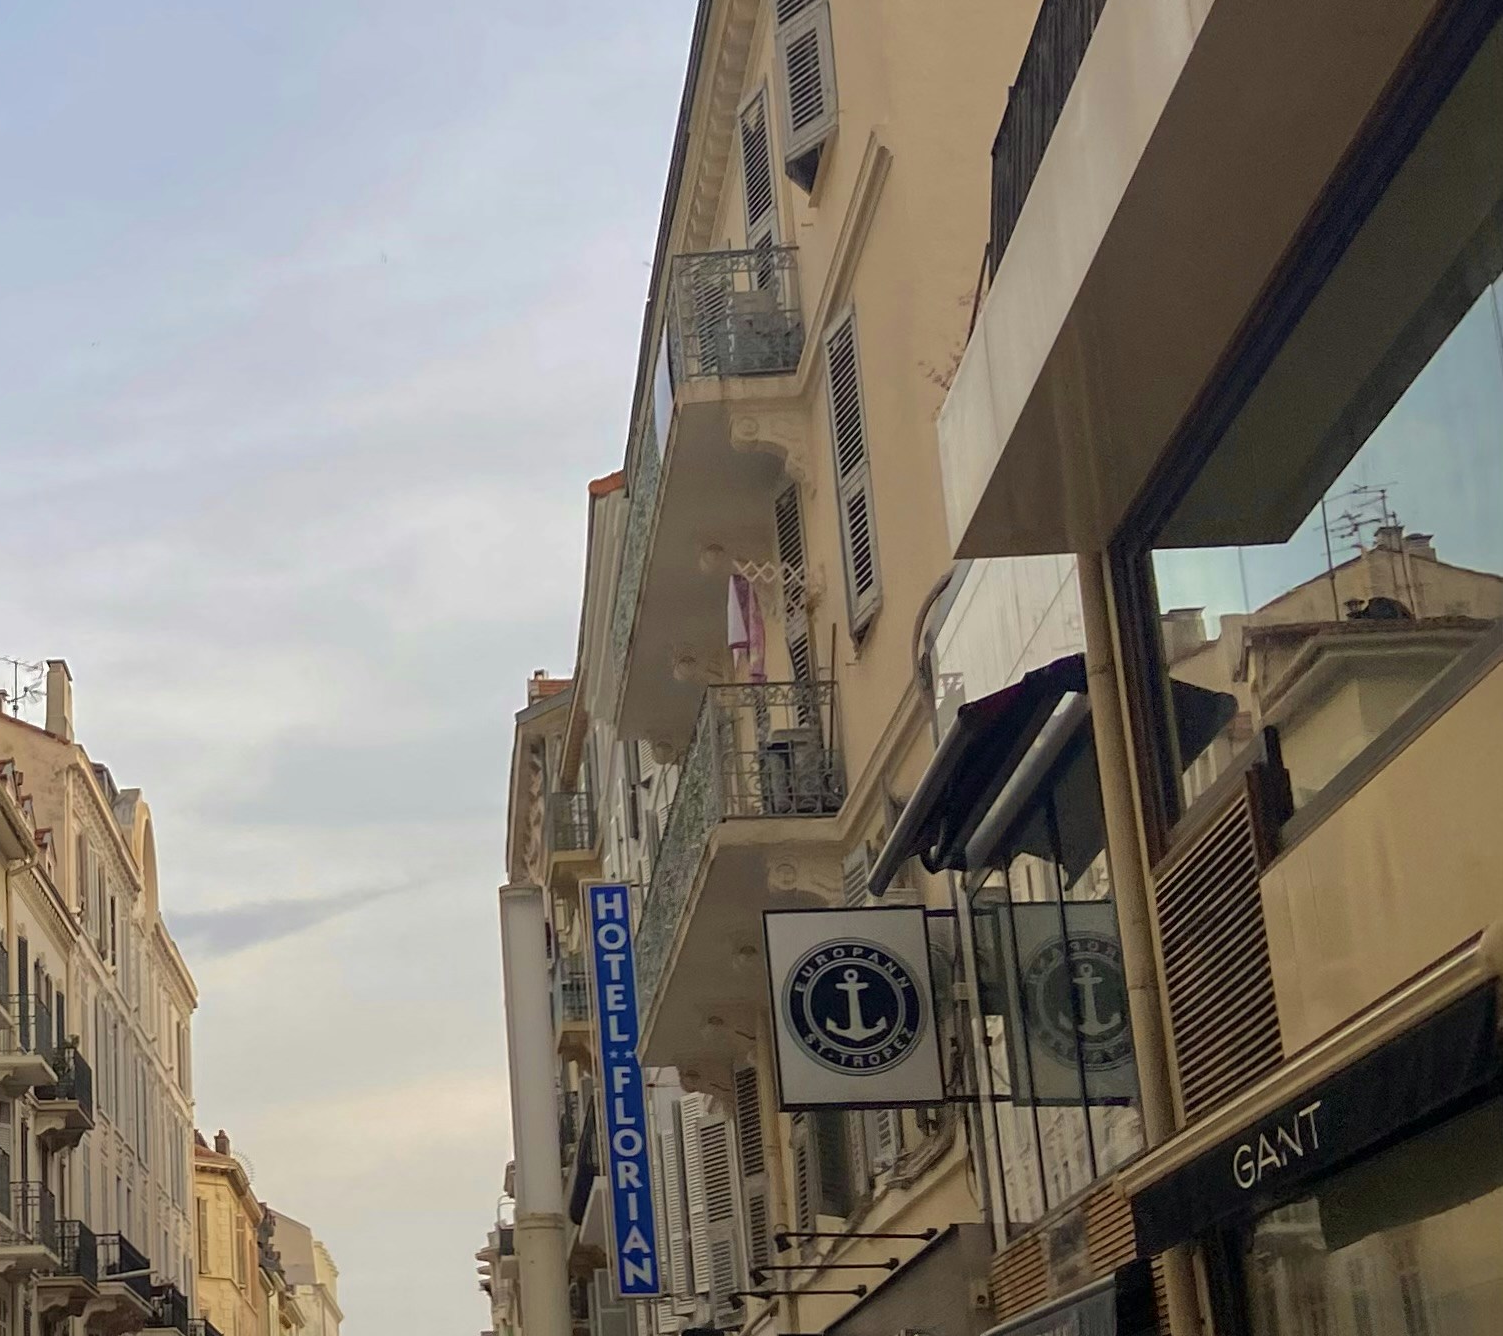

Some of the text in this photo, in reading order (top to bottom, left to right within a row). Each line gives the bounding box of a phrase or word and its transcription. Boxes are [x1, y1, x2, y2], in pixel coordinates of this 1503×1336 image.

[795, 947, 911, 993] EUROPANN
[804, 1027, 913, 1067] ST-TROPEZ
[597, 893, 653, 1287] HOTEL FLORIAN
[1234, 1100, 1322, 1189] GANT
